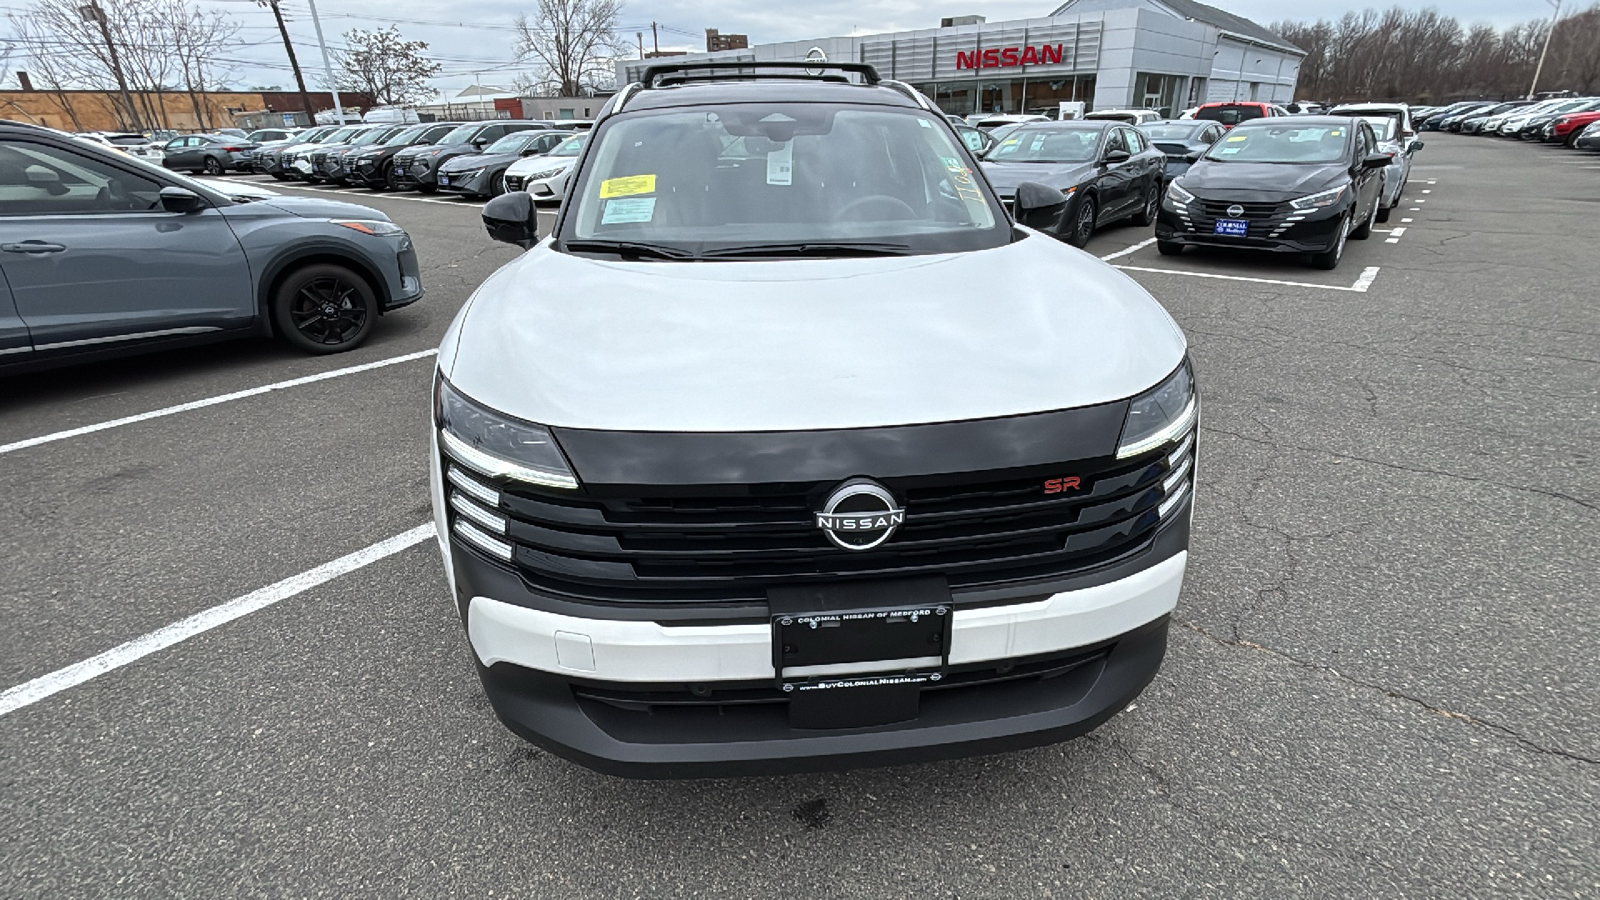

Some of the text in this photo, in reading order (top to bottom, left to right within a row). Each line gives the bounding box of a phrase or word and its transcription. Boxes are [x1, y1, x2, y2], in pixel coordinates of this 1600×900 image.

[957, 44, 1063, 70] NISSAN
[1044, 476, 1081, 494] SR
[818, 513, 903, 529] NISSAN
[798, 615, 841, 623] COLONIAL
[843, 612, 875, 620] NISSAN
